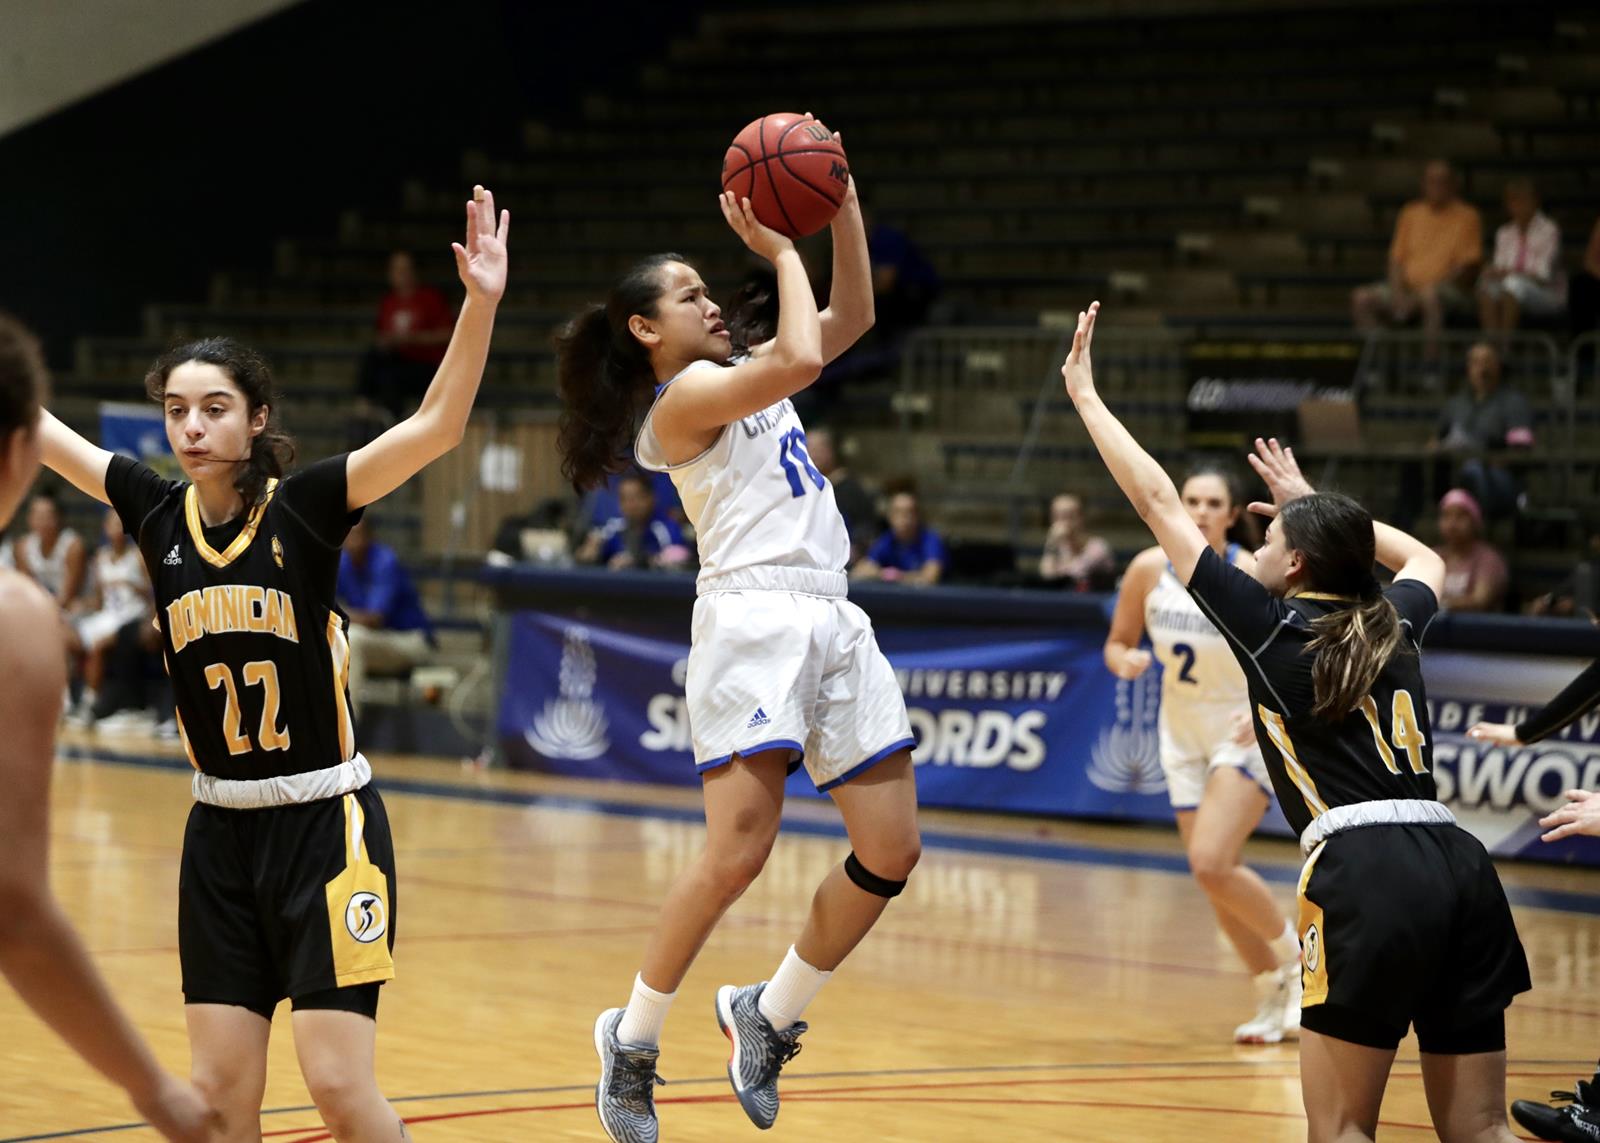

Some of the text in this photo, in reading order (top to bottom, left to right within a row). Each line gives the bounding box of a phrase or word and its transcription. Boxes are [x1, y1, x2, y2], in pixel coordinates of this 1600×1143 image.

[166, 584, 299, 654] DOMINICAN
[1172, 643, 1198, 684] 2
[204, 659, 291, 755] 22
[747, 717, 772, 729] adidas
[1360, 688, 1431, 775] 14
